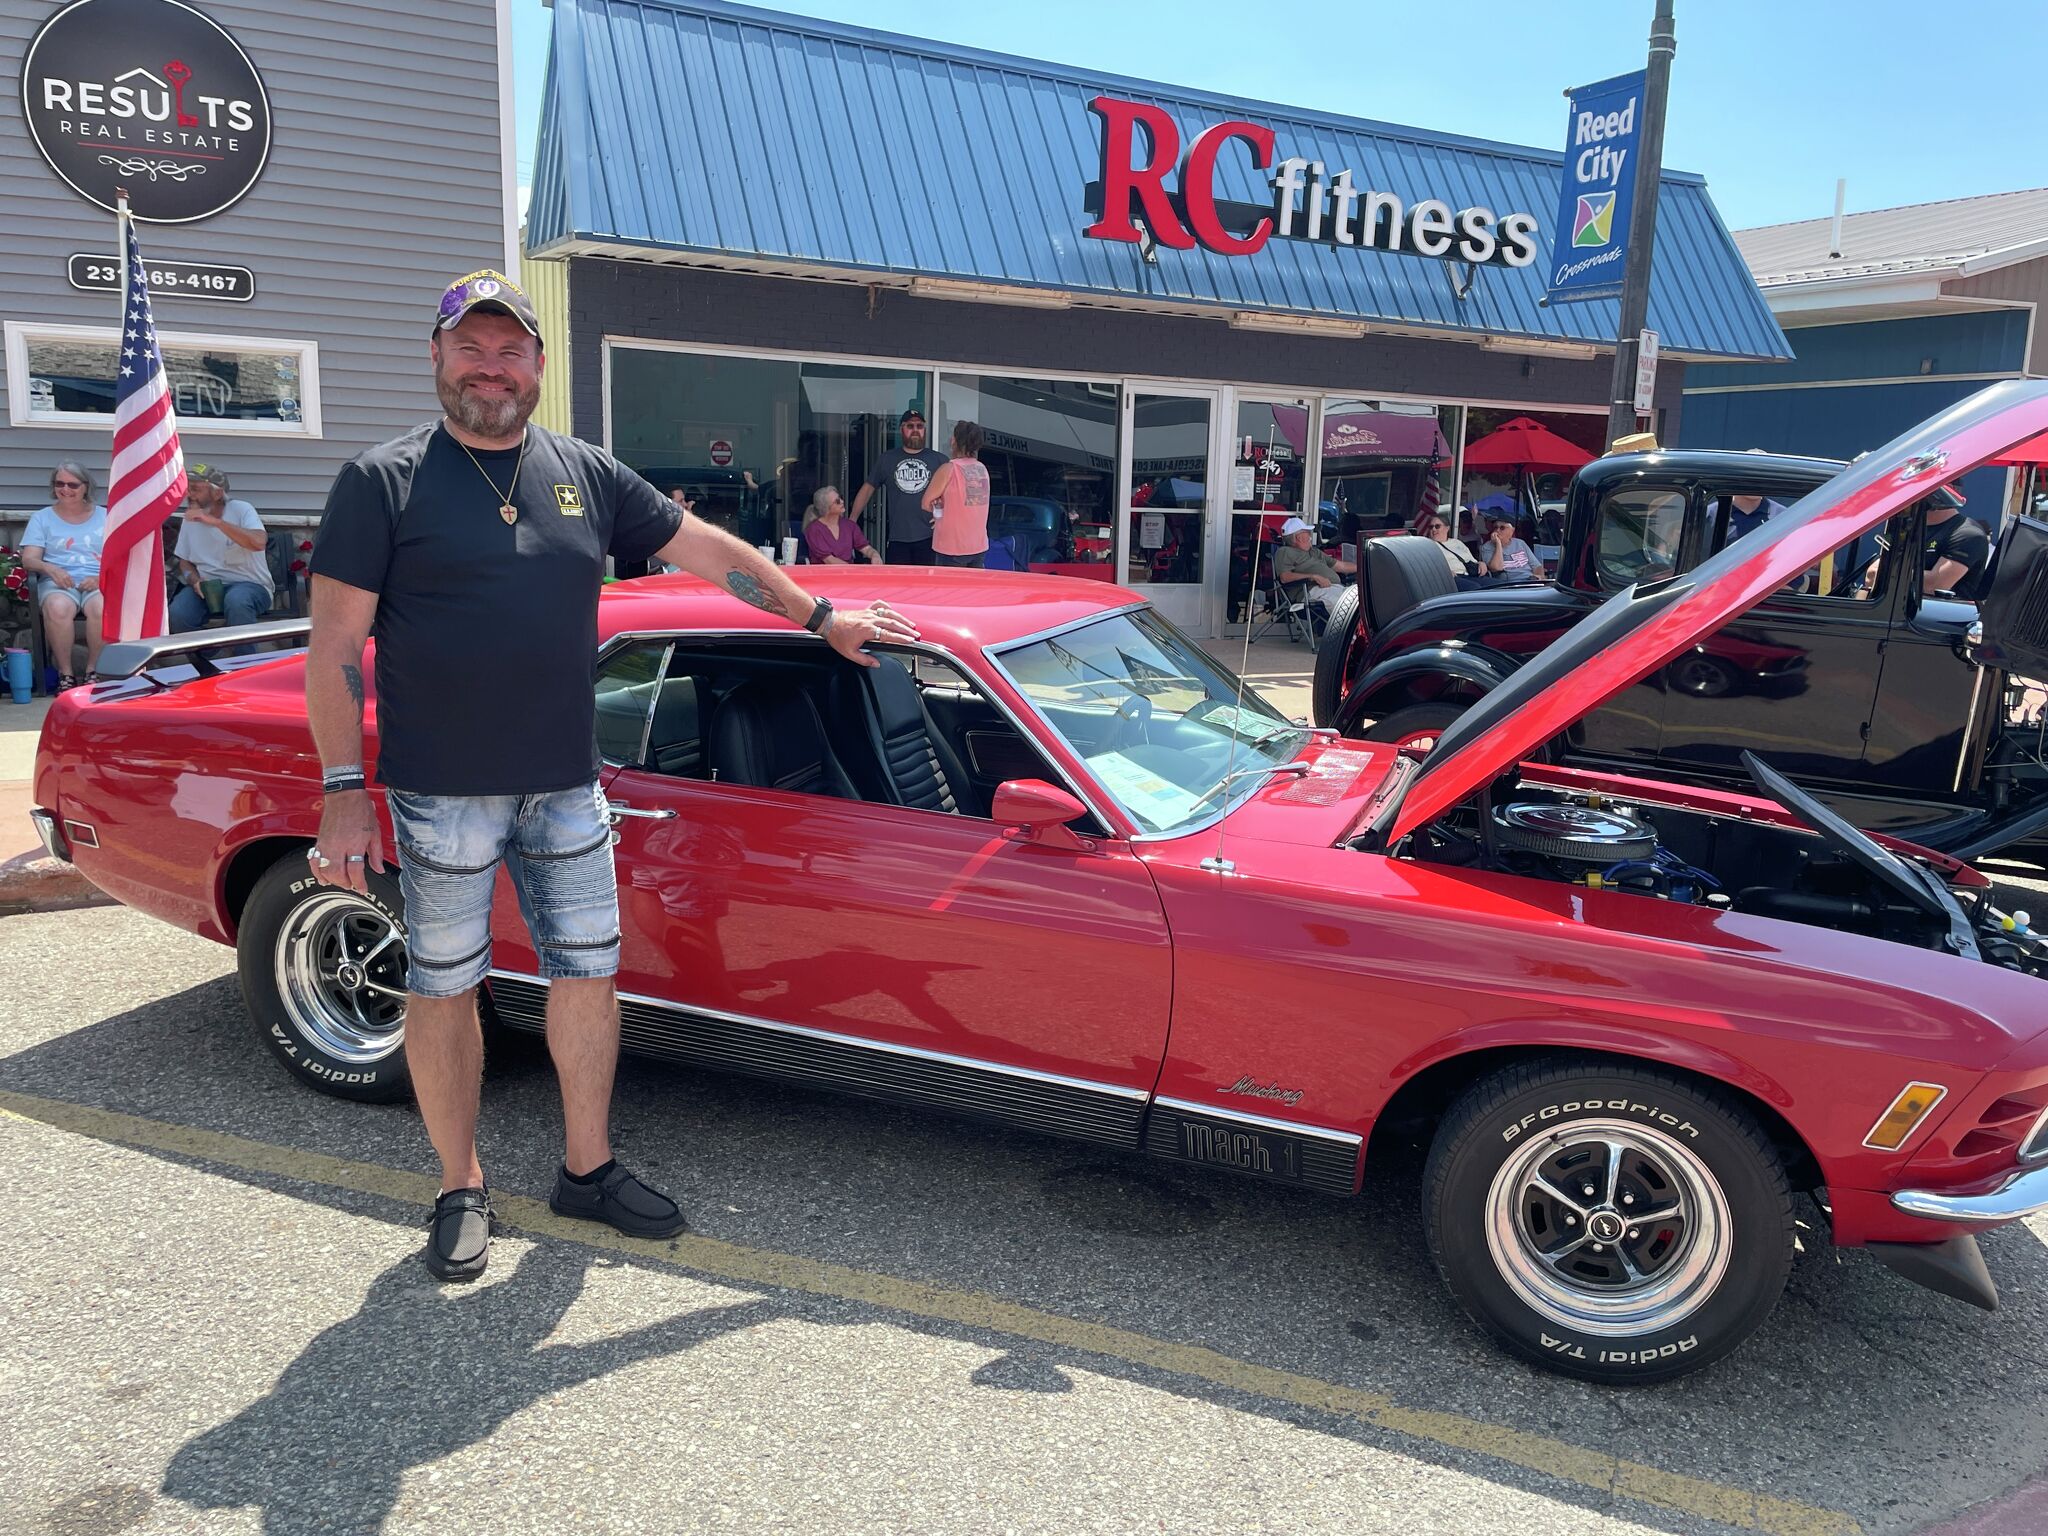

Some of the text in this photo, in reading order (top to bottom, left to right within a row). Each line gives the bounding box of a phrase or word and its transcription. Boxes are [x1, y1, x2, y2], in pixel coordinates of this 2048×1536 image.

[43, 60, 254, 131] RESULTS
[61, 120, 239, 152] REAL ESTATE
[1575, 96, 1637, 146] Reed
[1576, 146, 1627, 186] City
[1269, 157, 1538, 267] fitness
[87, 265, 237, 291] 2365-4167
[451, 271, 523, 296] PURPLE HEART
[1555, 246, 1623, 286] Crossroads
[895, 469, 931, 481] VANDELAY
[271, 1022, 377, 1084] Radial T/A
[1216, 1075, 1304, 1107] Mustang
[1502, 1099, 1699, 1143] BFGoodrich
[1282, 1143, 1297, 1177] 1
[1539, 1332, 1698, 1365] Radial T/A
